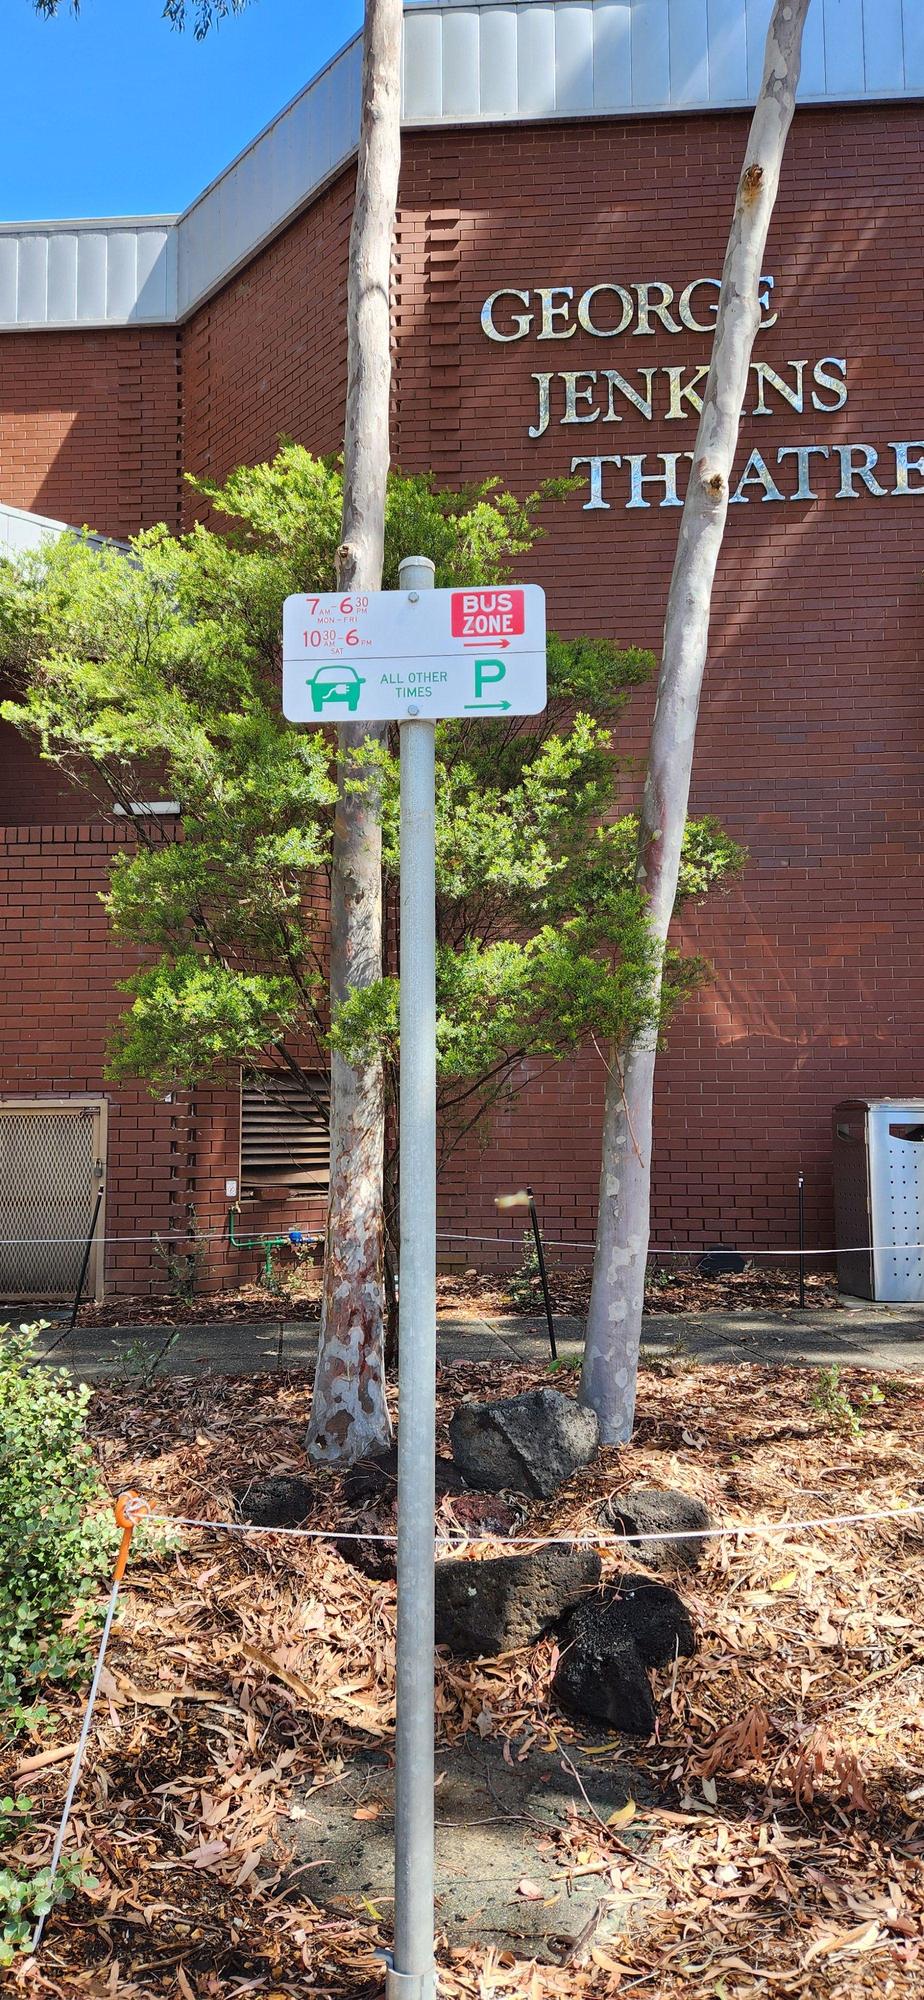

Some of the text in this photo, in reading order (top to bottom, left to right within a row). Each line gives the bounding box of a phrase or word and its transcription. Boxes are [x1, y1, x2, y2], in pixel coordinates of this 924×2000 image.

[528, 357, 848, 439] JENKNS
[570, 441, 924, 510] THATRE
[463, 593, 513, 614] BUS
[462, 614, 514, 635] ZONE
[330, 647, 344, 655] SAT
[380, 671, 448, 685] ALL OTHER
[474, 659, 507, 698] P
[395, 686, 433, 698] TIMES
